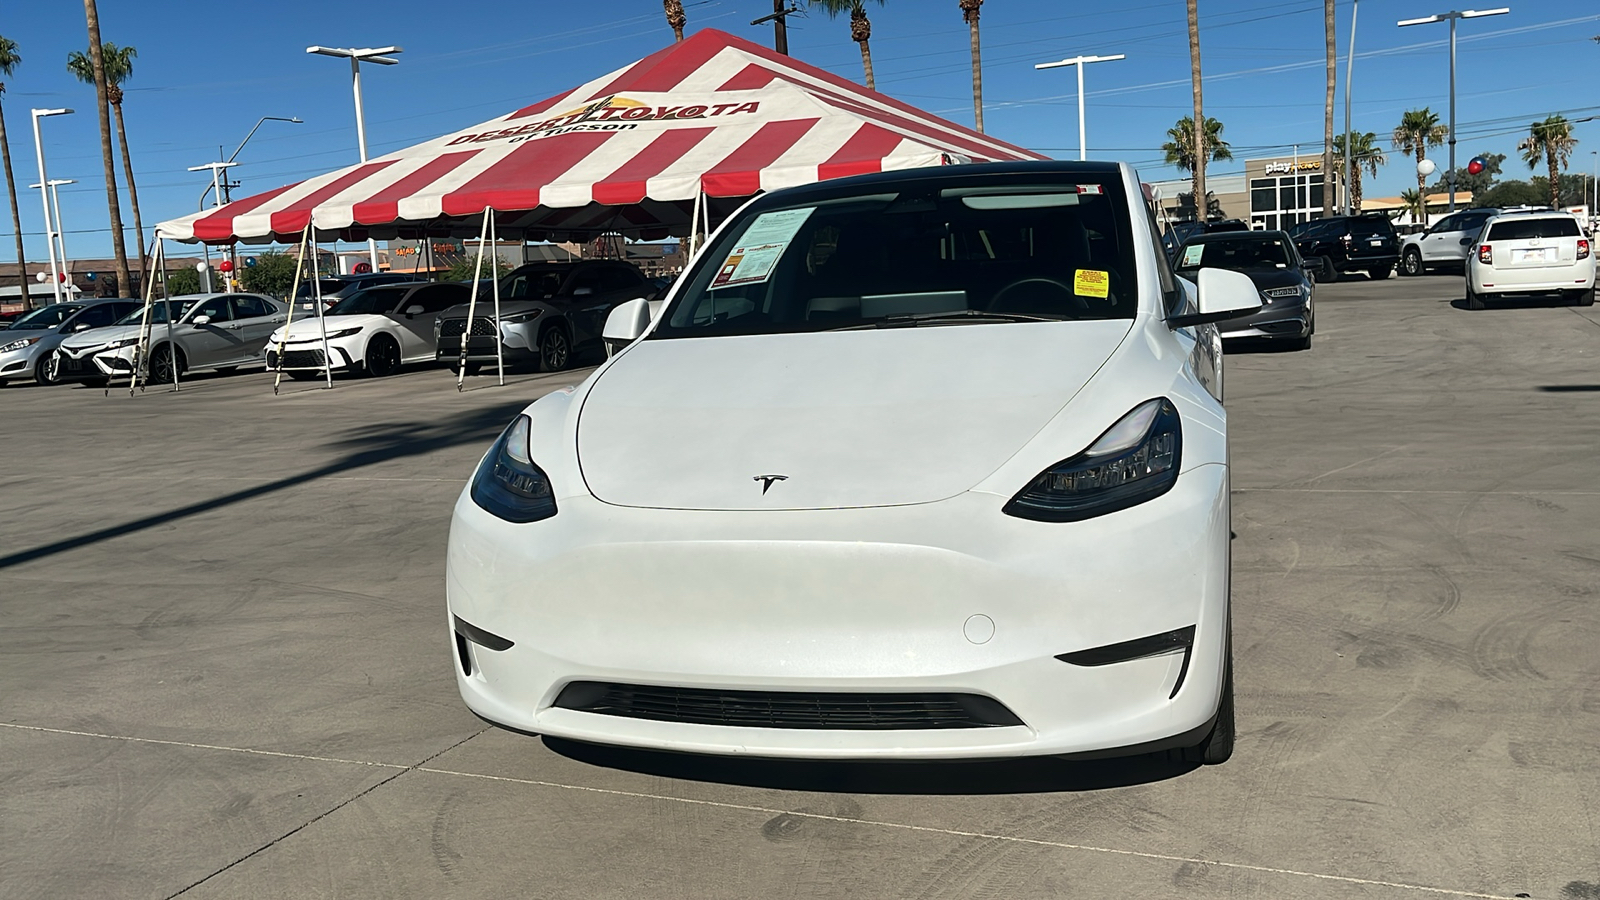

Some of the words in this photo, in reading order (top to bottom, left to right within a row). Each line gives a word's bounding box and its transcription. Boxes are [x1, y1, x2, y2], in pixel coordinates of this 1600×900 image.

[444, 112, 586, 147] DESERT
[598, 101, 760, 121] TOYOTA
[508, 133, 537, 144] of
[543, 123, 638, 138] Tucson
